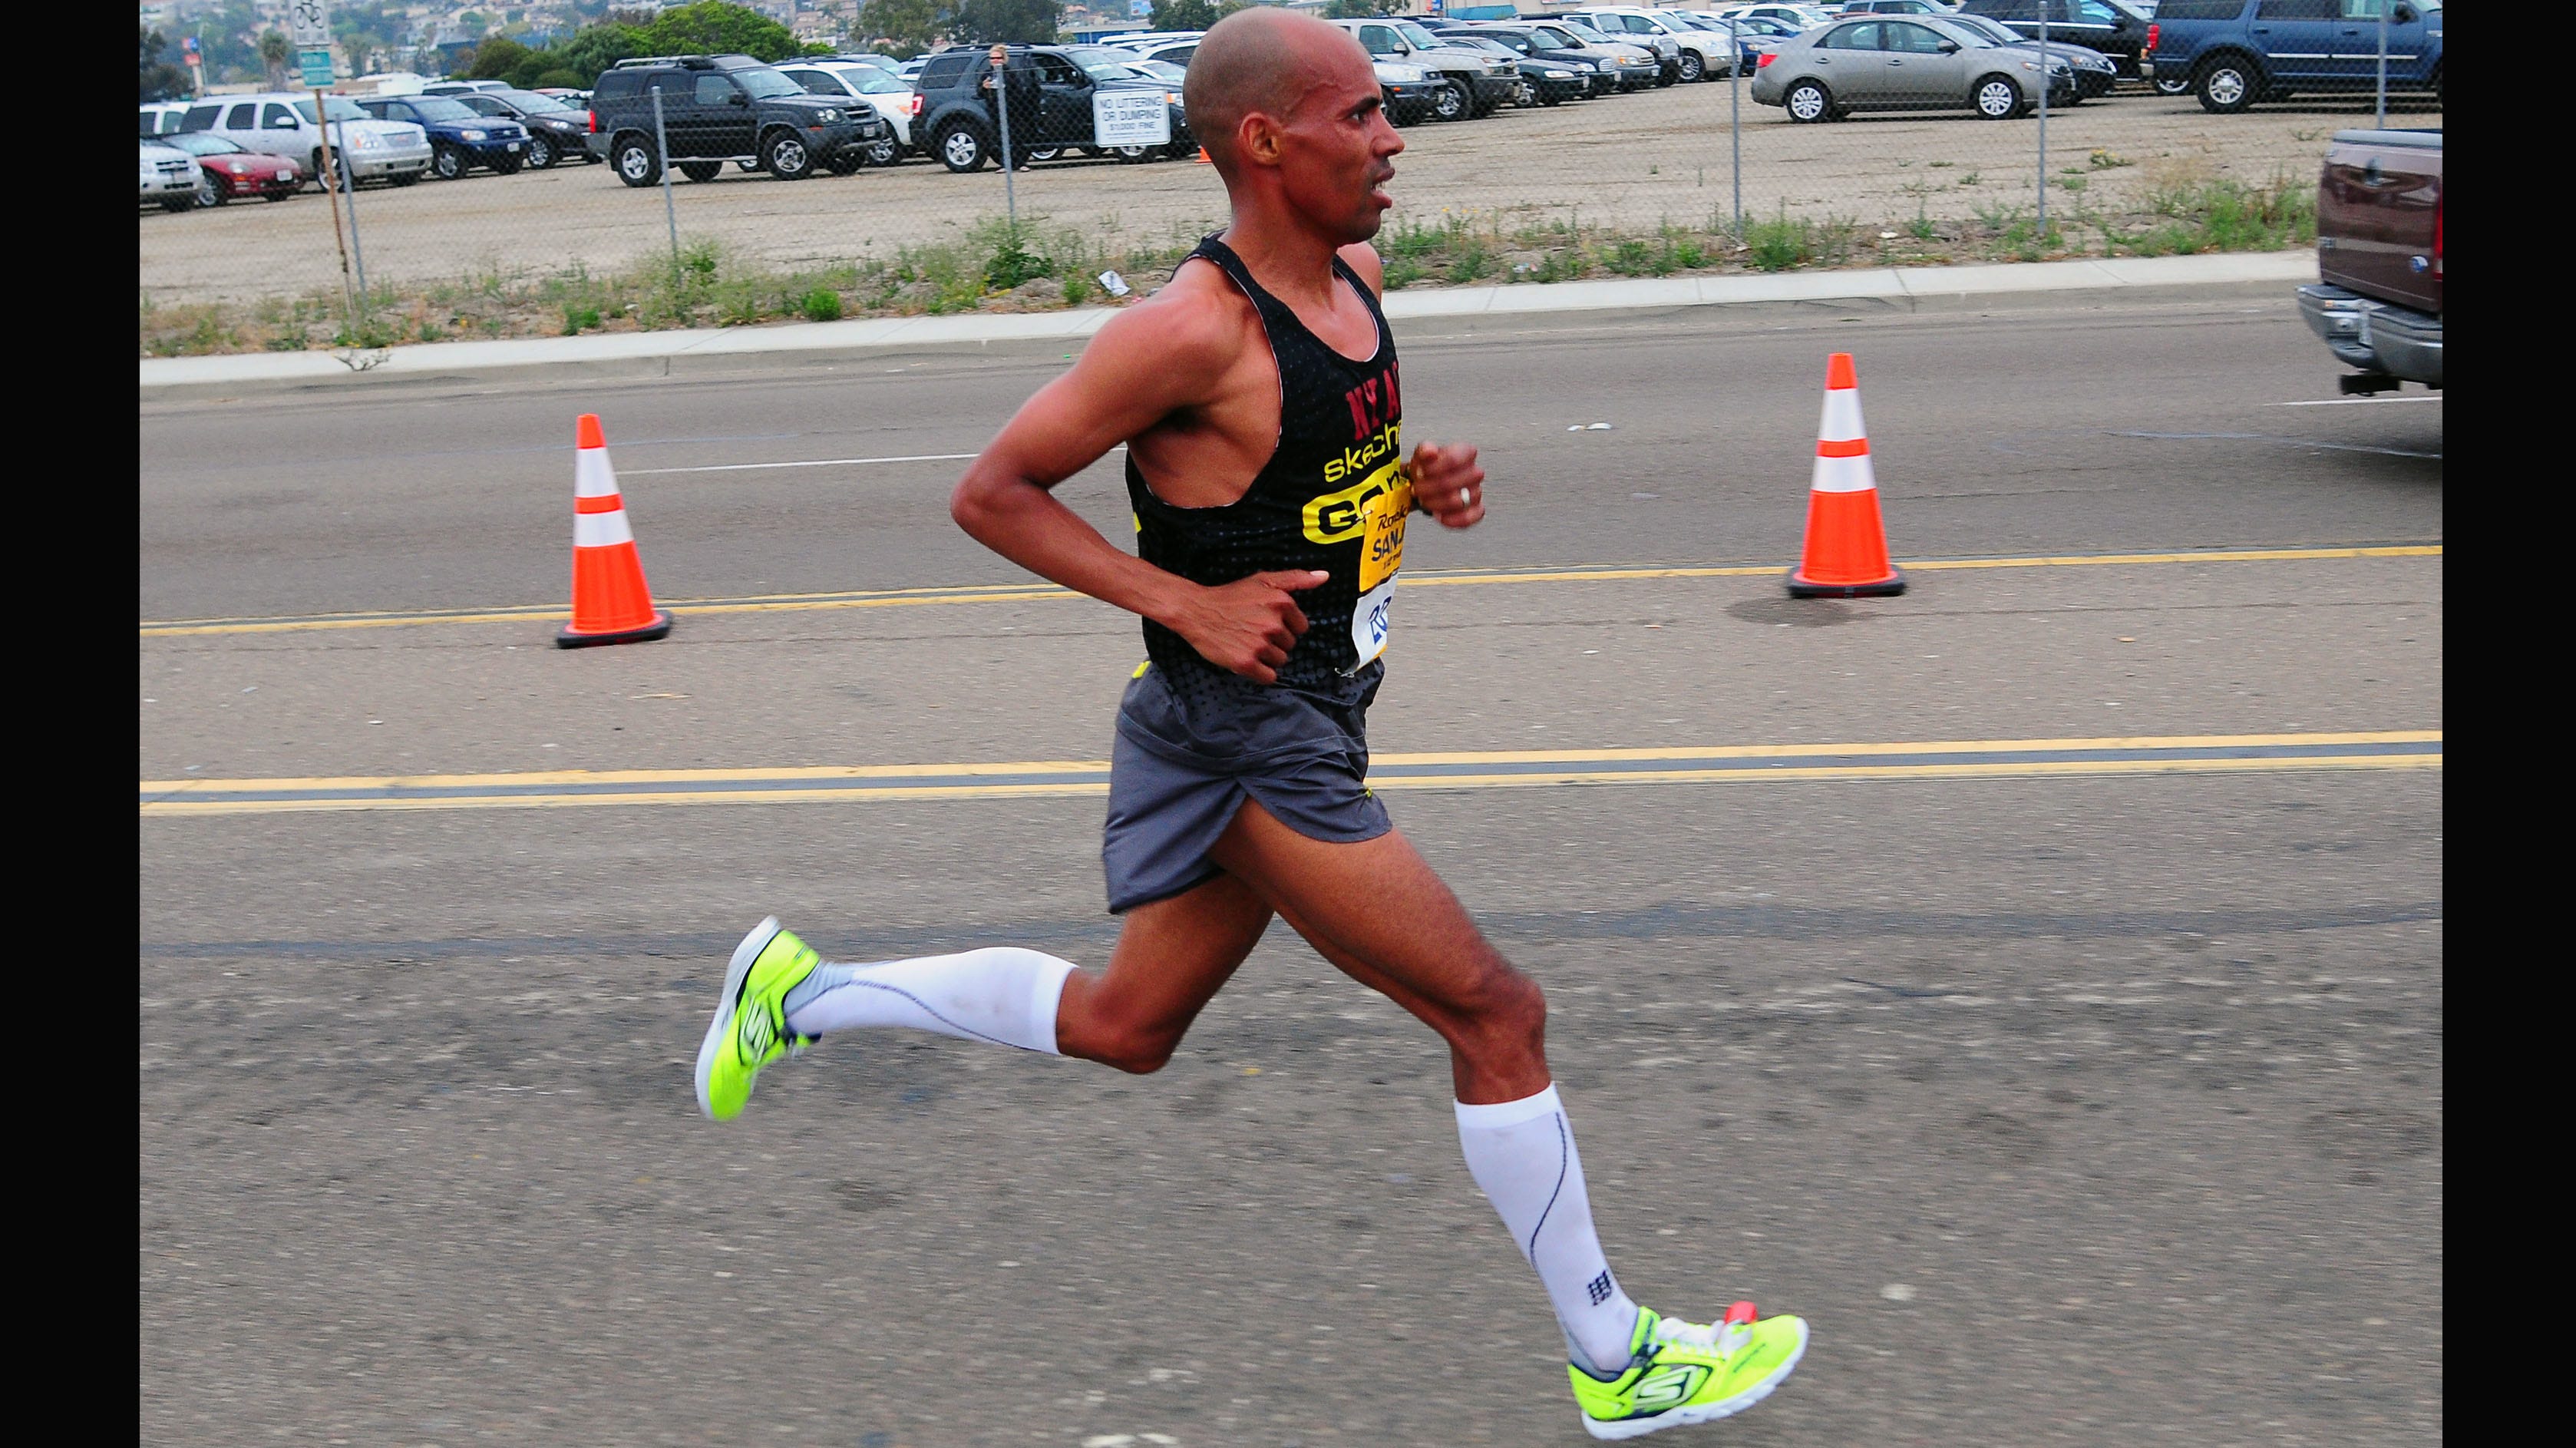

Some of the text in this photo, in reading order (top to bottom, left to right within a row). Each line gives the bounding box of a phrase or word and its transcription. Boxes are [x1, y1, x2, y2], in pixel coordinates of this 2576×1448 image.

[1100, 96, 1162, 109] NO LITTERING
[1103, 109, 1161, 121] OR DUMPING
